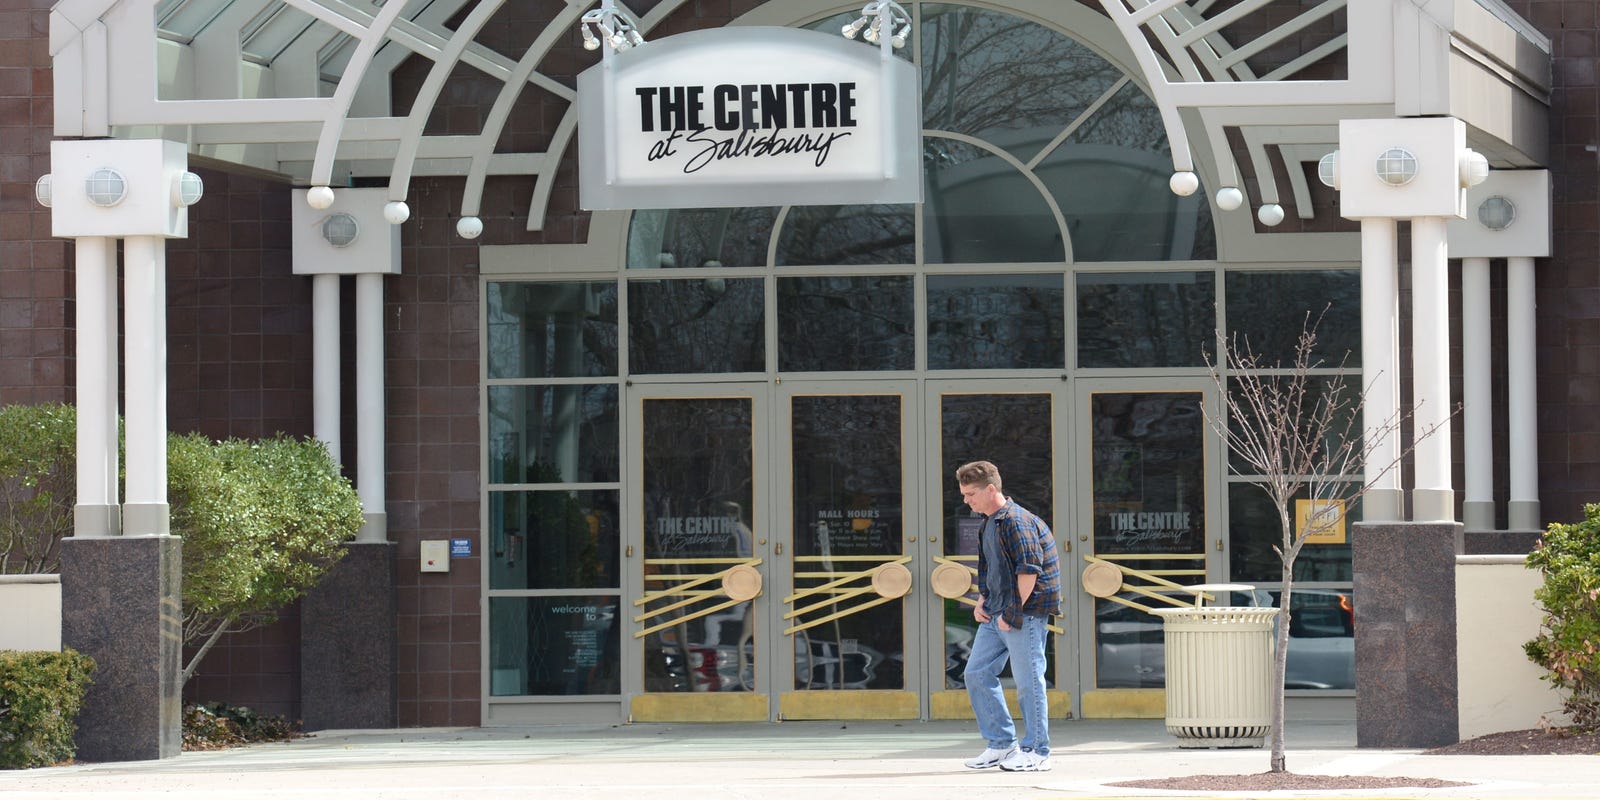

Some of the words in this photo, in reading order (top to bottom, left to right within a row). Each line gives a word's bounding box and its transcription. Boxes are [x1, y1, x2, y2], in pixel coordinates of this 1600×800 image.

[635, 85, 704, 132] THE
[713, 82, 857, 131] CENTRE
[647, 129, 683, 161] at
[683, 126, 852, 174] Salisbury
[818, 510, 843, 518] MALL
[847, 510, 880, 518] HOURS
[1109, 512, 1136, 530] THE
[1137, 511, 1191, 530] CENTRE
[657, 517, 684, 534] THE
[552, 604, 597, 614] welcome
[585, 613, 597, 621] to
